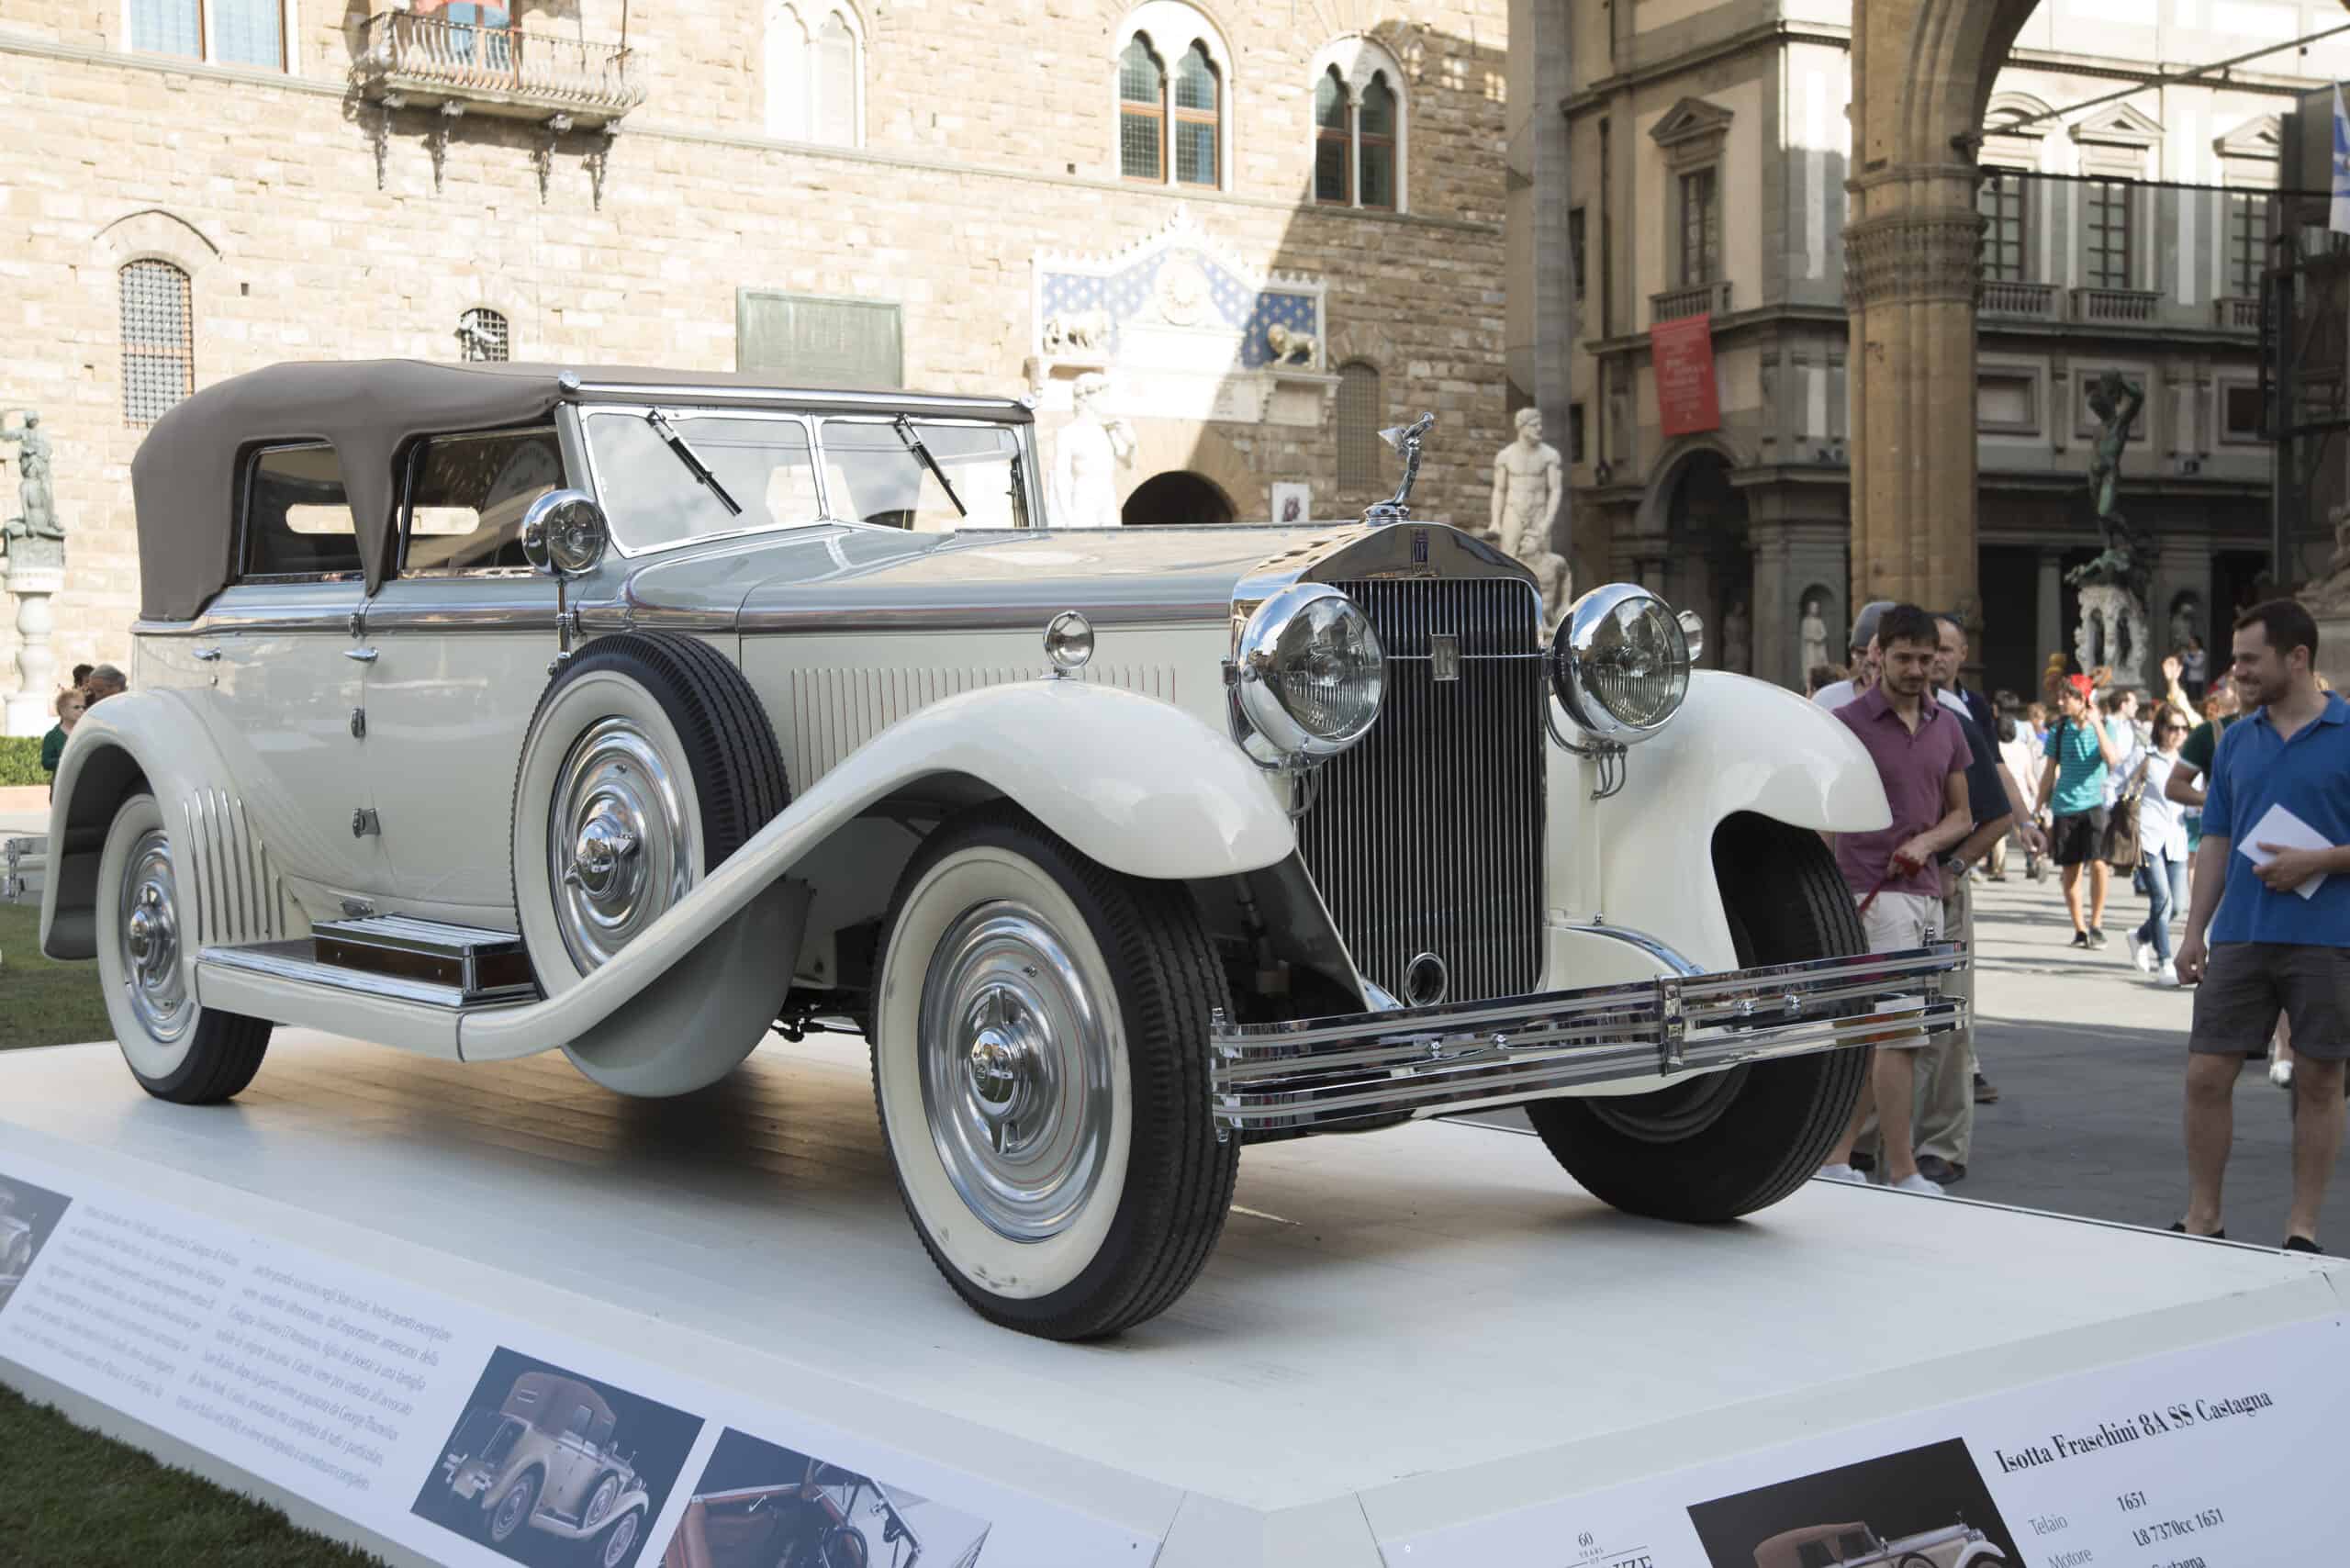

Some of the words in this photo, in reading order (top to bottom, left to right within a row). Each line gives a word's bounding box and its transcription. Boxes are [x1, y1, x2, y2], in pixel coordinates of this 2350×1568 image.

[1994, 1447, 2054, 1473] Isotta
[2051, 1419, 2140, 1459] Fraschini
[2138, 1410, 2169, 1436] 8A
[2167, 1403, 2194, 1428] SS
[2195, 1392, 2273, 1421] Castagna
[1578, 1530, 1594, 1547] 60
[2027, 1514, 2068, 1535] Telaio
[2117, 1491, 2146, 1511] 1651
[2047, 1550, 2093, 1568] Motore
[2132, 1529, 2151, 1547] L8
[2149, 1520, 2195, 1541] 7370cc
[2196, 1508, 2224, 1529] 1651
